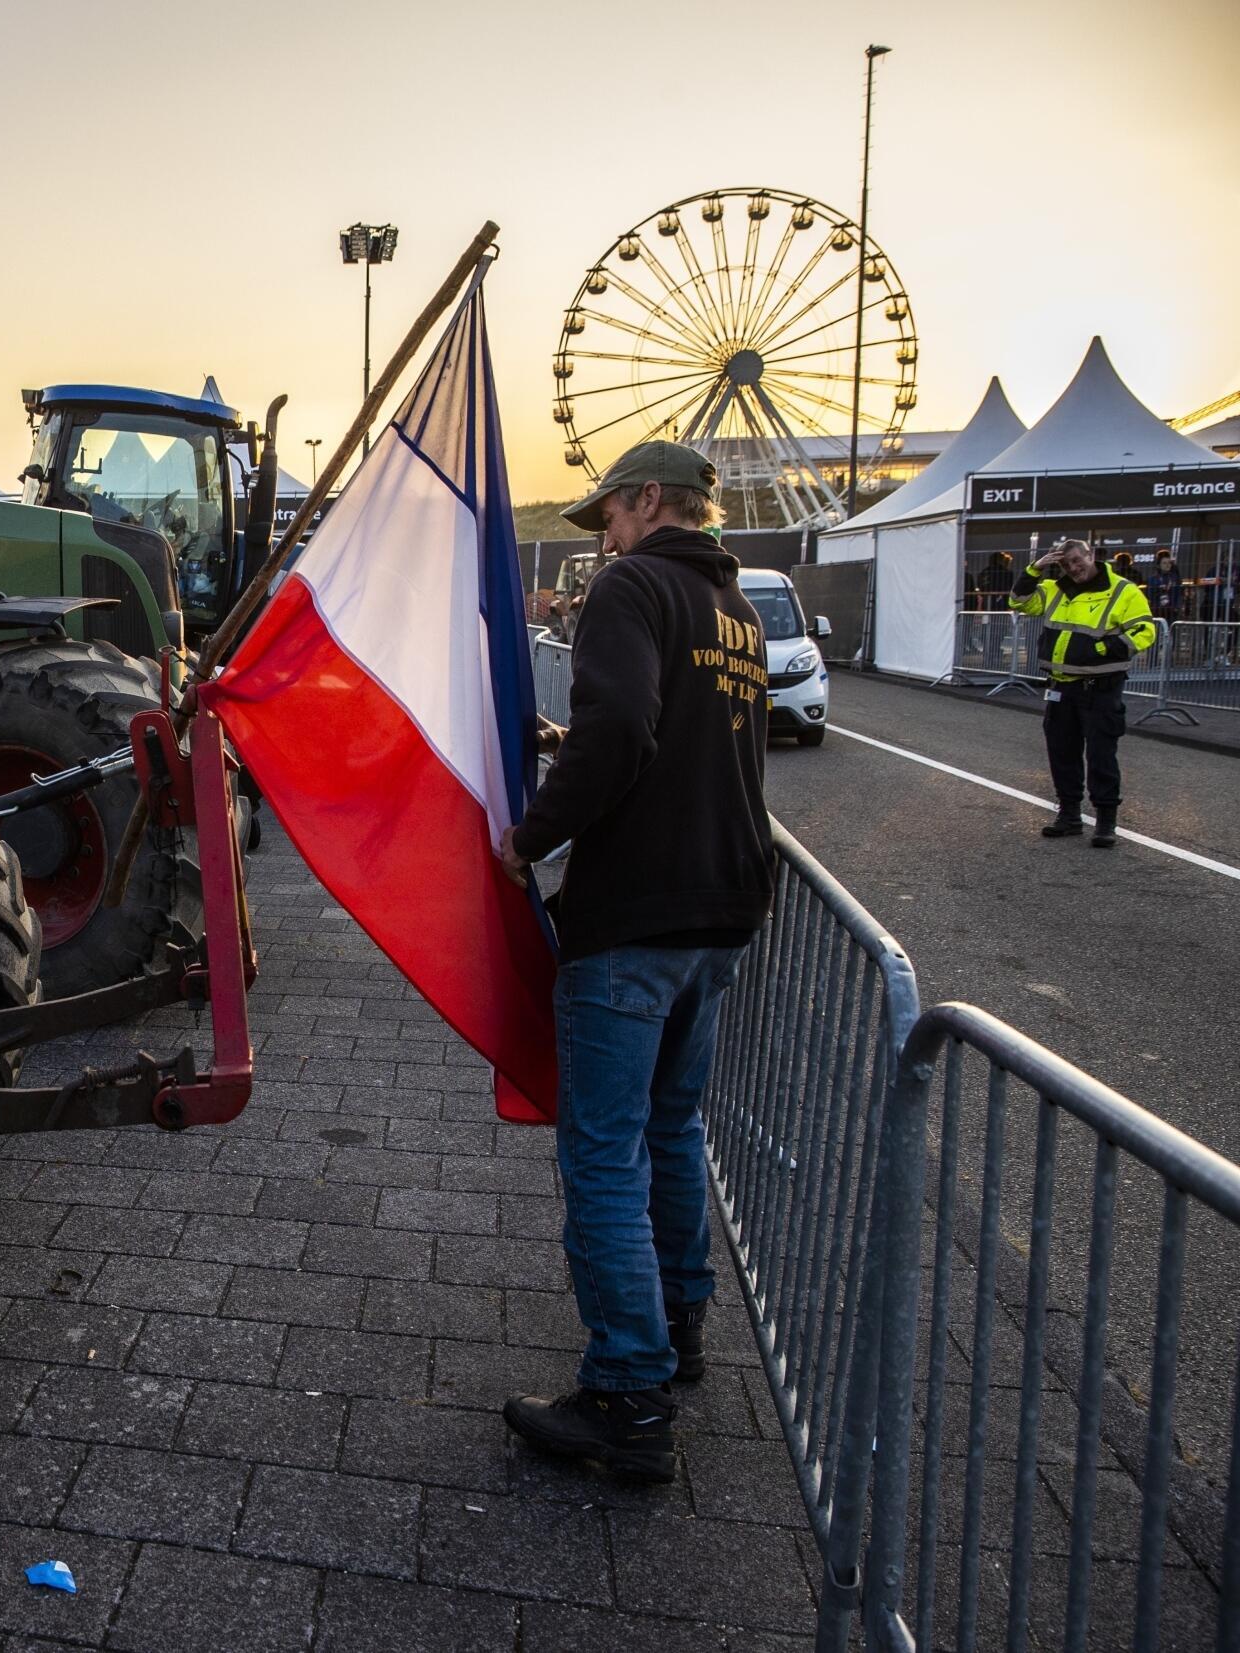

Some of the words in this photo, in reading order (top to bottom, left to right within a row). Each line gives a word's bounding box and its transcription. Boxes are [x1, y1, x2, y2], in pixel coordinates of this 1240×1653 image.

[982, 488, 1024, 503] EXIT
[1152, 481, 1236, 497] Entrance
[274, 508, 321, 521] trae
[714, 607, 758, 656] FDF
[692, 648, 726, 667] VOO
[728, 656, 769, 687] BOERE
[716, 673, 737, 697] MT
